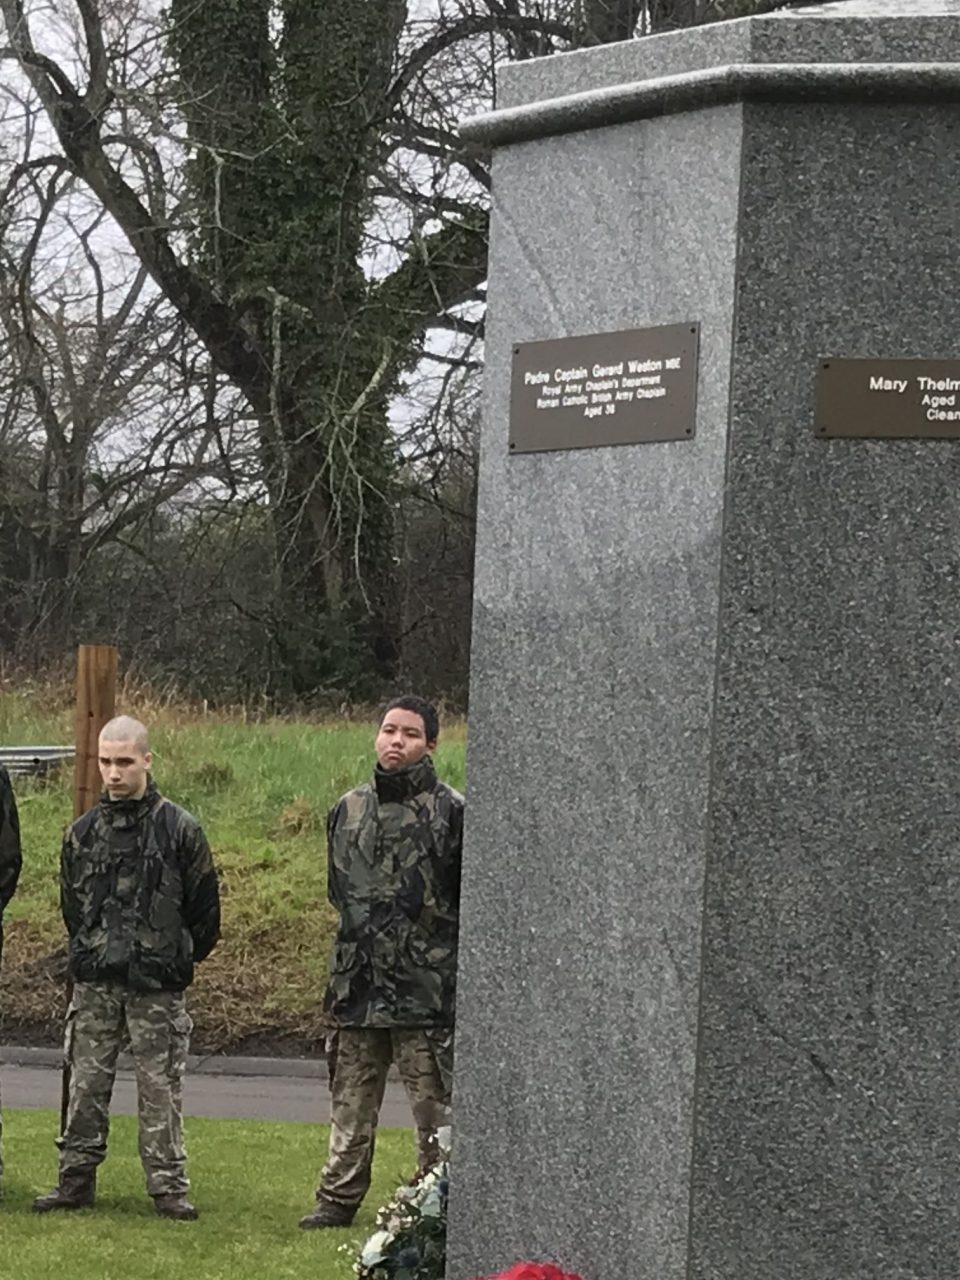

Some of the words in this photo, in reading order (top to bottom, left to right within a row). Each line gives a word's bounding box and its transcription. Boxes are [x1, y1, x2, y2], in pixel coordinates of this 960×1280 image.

[524, 371, 550, 385] Padre
[554, 366, 587, 383] Captain
[592, 362, 623, 377] Gerard
[870, 376, 908, 392] Mary
[922, 395, 955, 407] Aged
[584, 406, 602, 418] Aged
